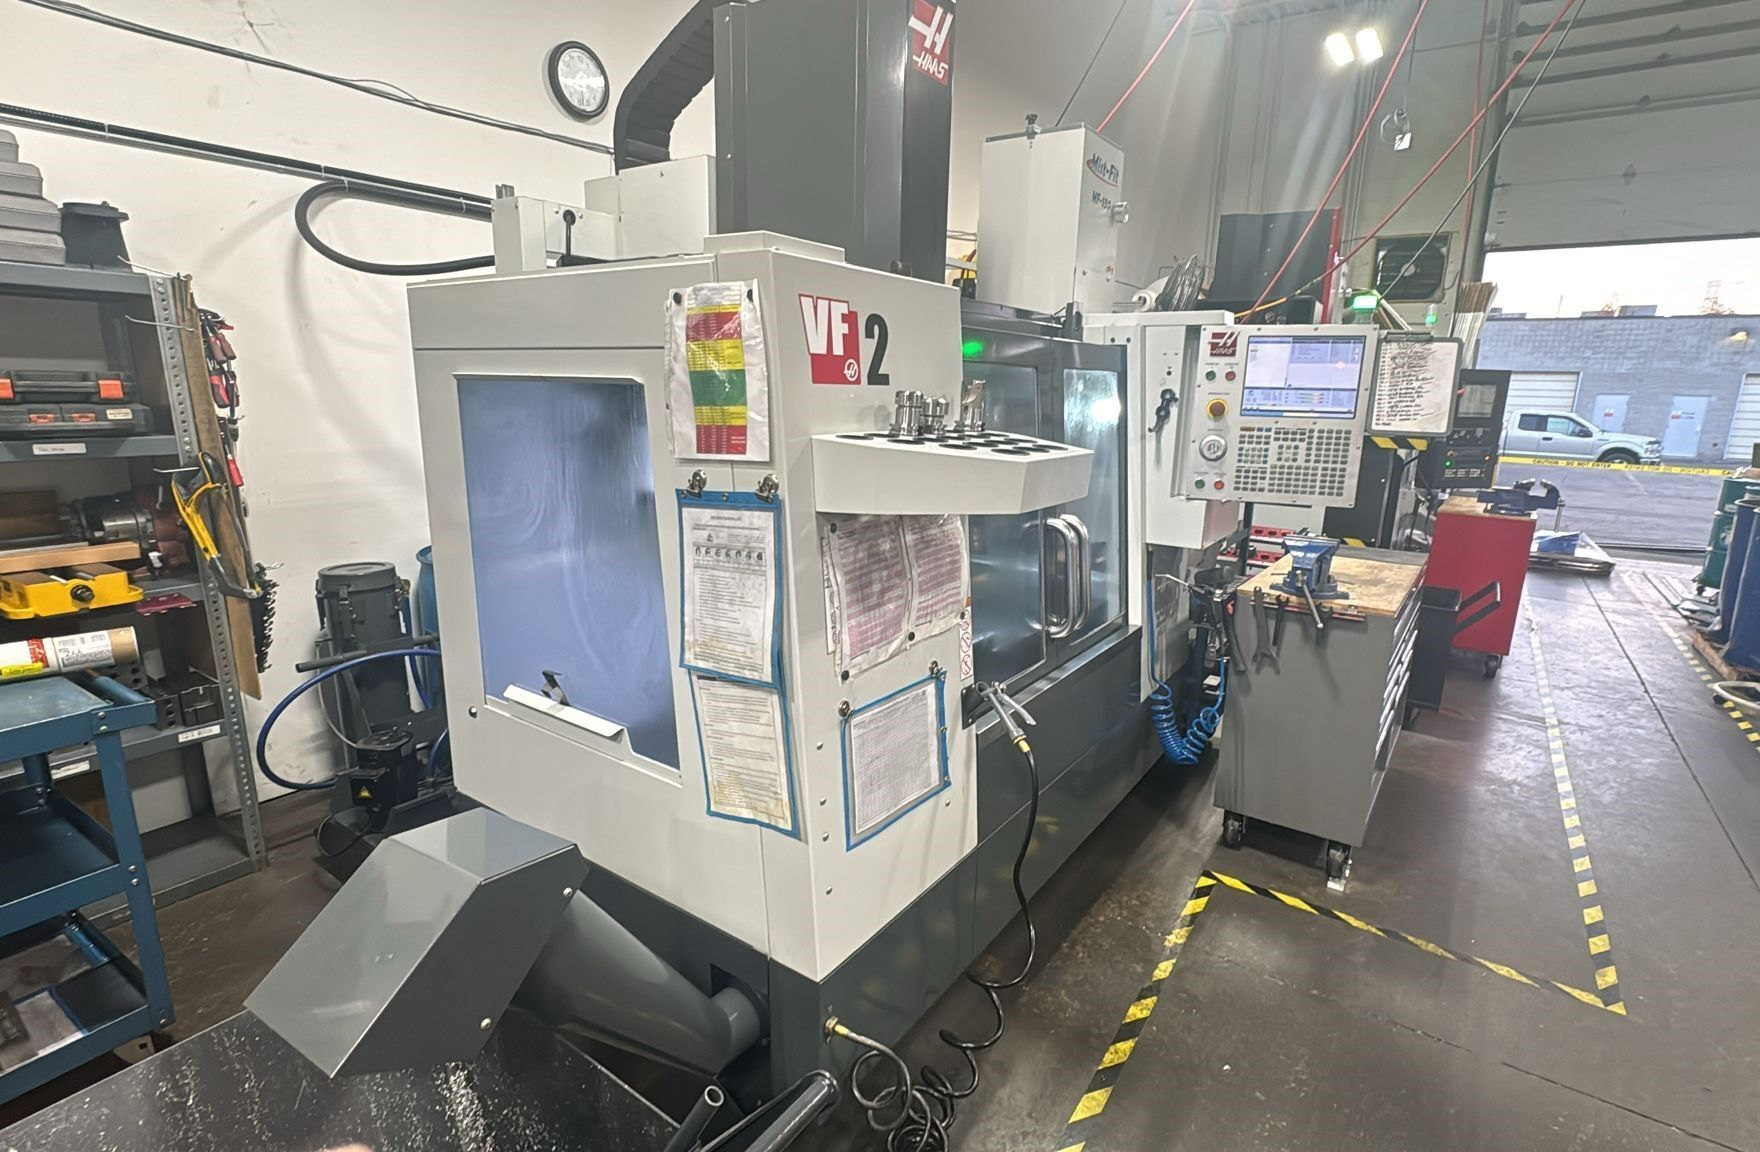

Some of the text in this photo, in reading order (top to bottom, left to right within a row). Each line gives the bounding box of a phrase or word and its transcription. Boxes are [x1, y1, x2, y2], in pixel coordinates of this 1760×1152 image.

[912, 50, 949, 80] HAAS
[800, 295, 890, 386] VF 2
